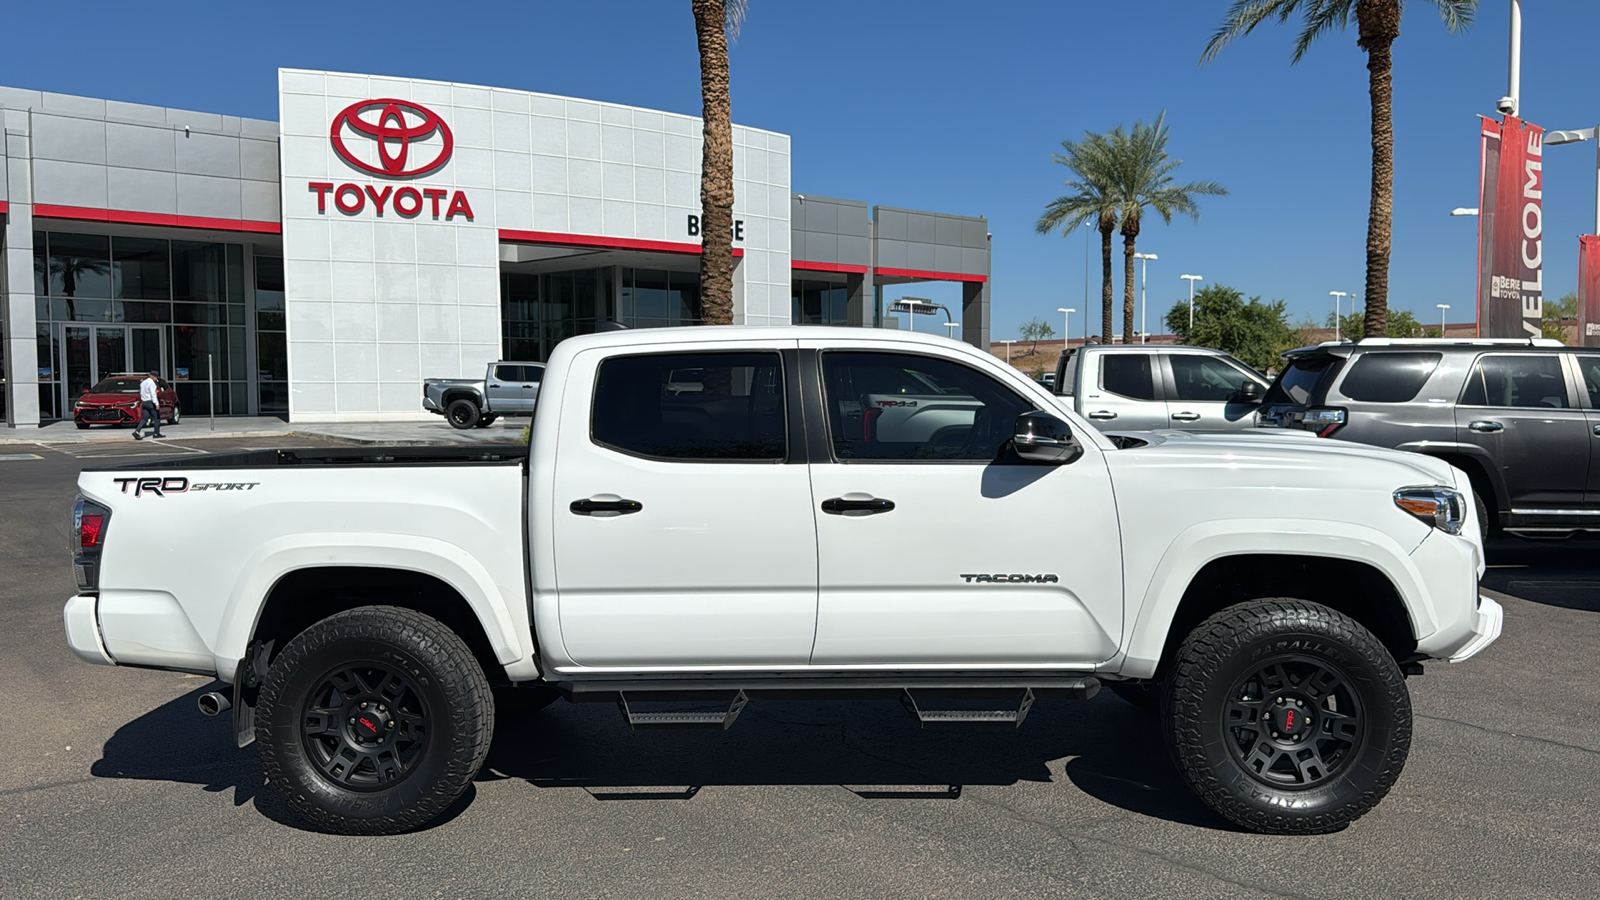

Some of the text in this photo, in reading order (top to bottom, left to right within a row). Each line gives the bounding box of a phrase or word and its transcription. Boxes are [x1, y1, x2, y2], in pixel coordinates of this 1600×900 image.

[308, 182, 475, 222] TOYOTA
[113, 477, 260, 498] TRD SPORT
[960, 574, 1058, 583] TACOMA
[359, 717, 377, 733] TRD
[1286, 710, 1294, 731] TRD
